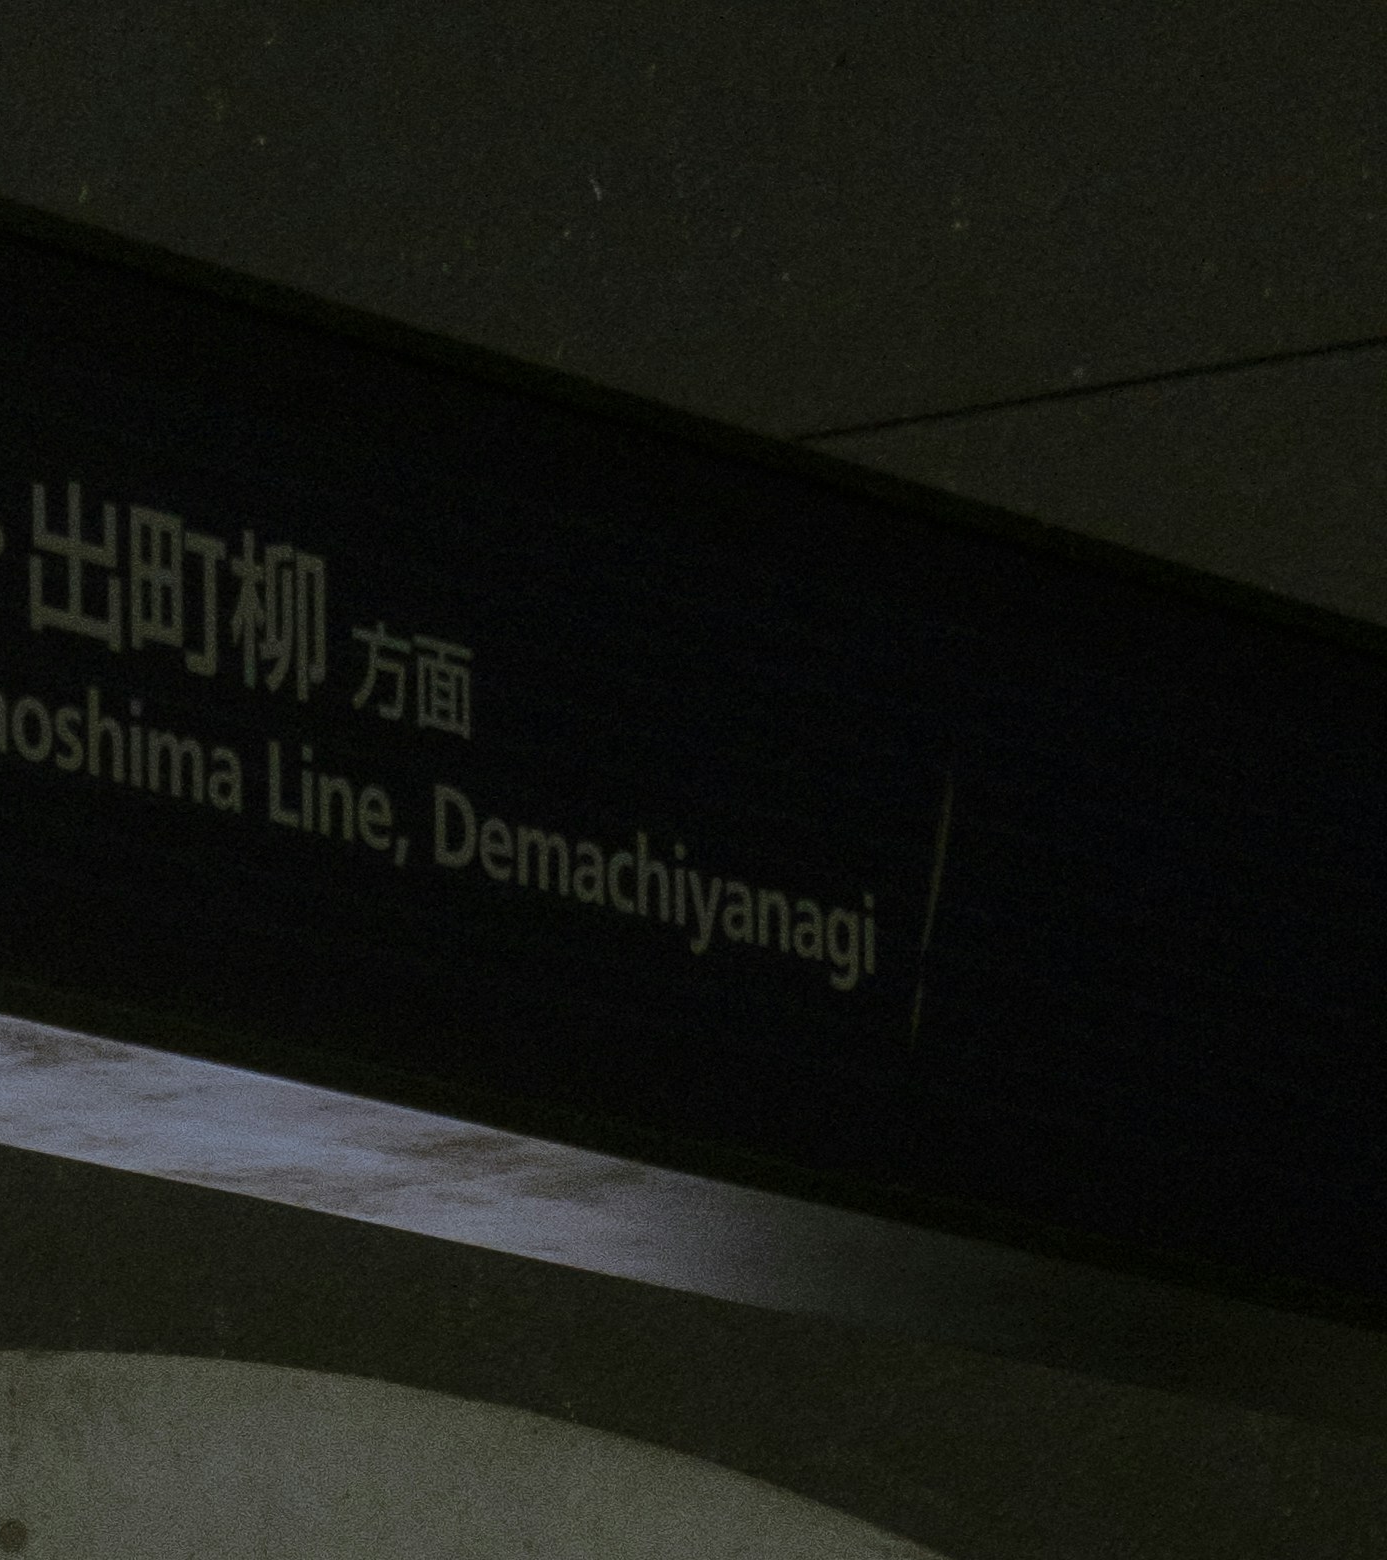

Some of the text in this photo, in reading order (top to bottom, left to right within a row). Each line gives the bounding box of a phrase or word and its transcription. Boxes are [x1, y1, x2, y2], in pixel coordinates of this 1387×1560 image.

[349, 620, 474, 741] 方面
[265, 738, 410, 869] Line,
[431, 784, 877, 995] Demachiyanagi
